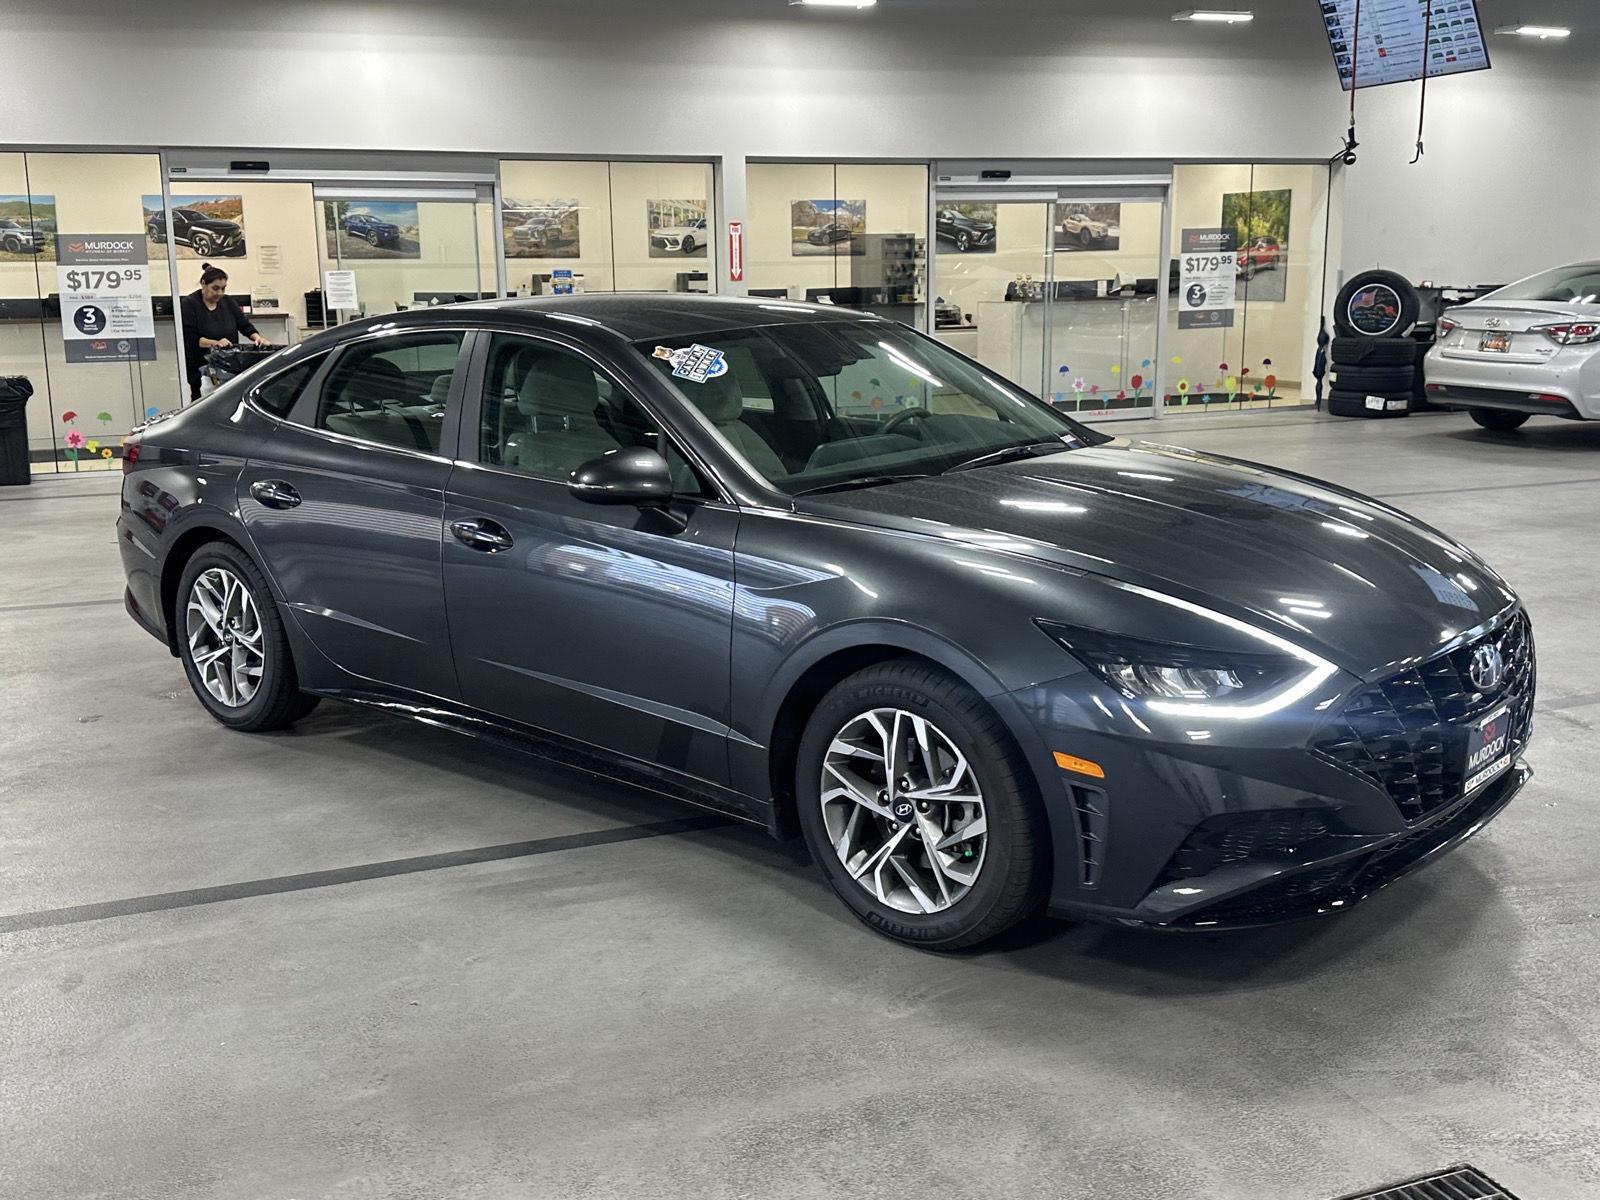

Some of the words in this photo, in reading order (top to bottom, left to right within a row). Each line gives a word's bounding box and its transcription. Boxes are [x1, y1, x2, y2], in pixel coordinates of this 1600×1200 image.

[1199, 233, 1231, 241] MURDOCK
[84, 241, 134, 250] MURDOCK
[1192, 286, 1201, 299] 3
[83, 308, 96, 324] 3
[1468, 734, 1506, 770] MURDOCK
